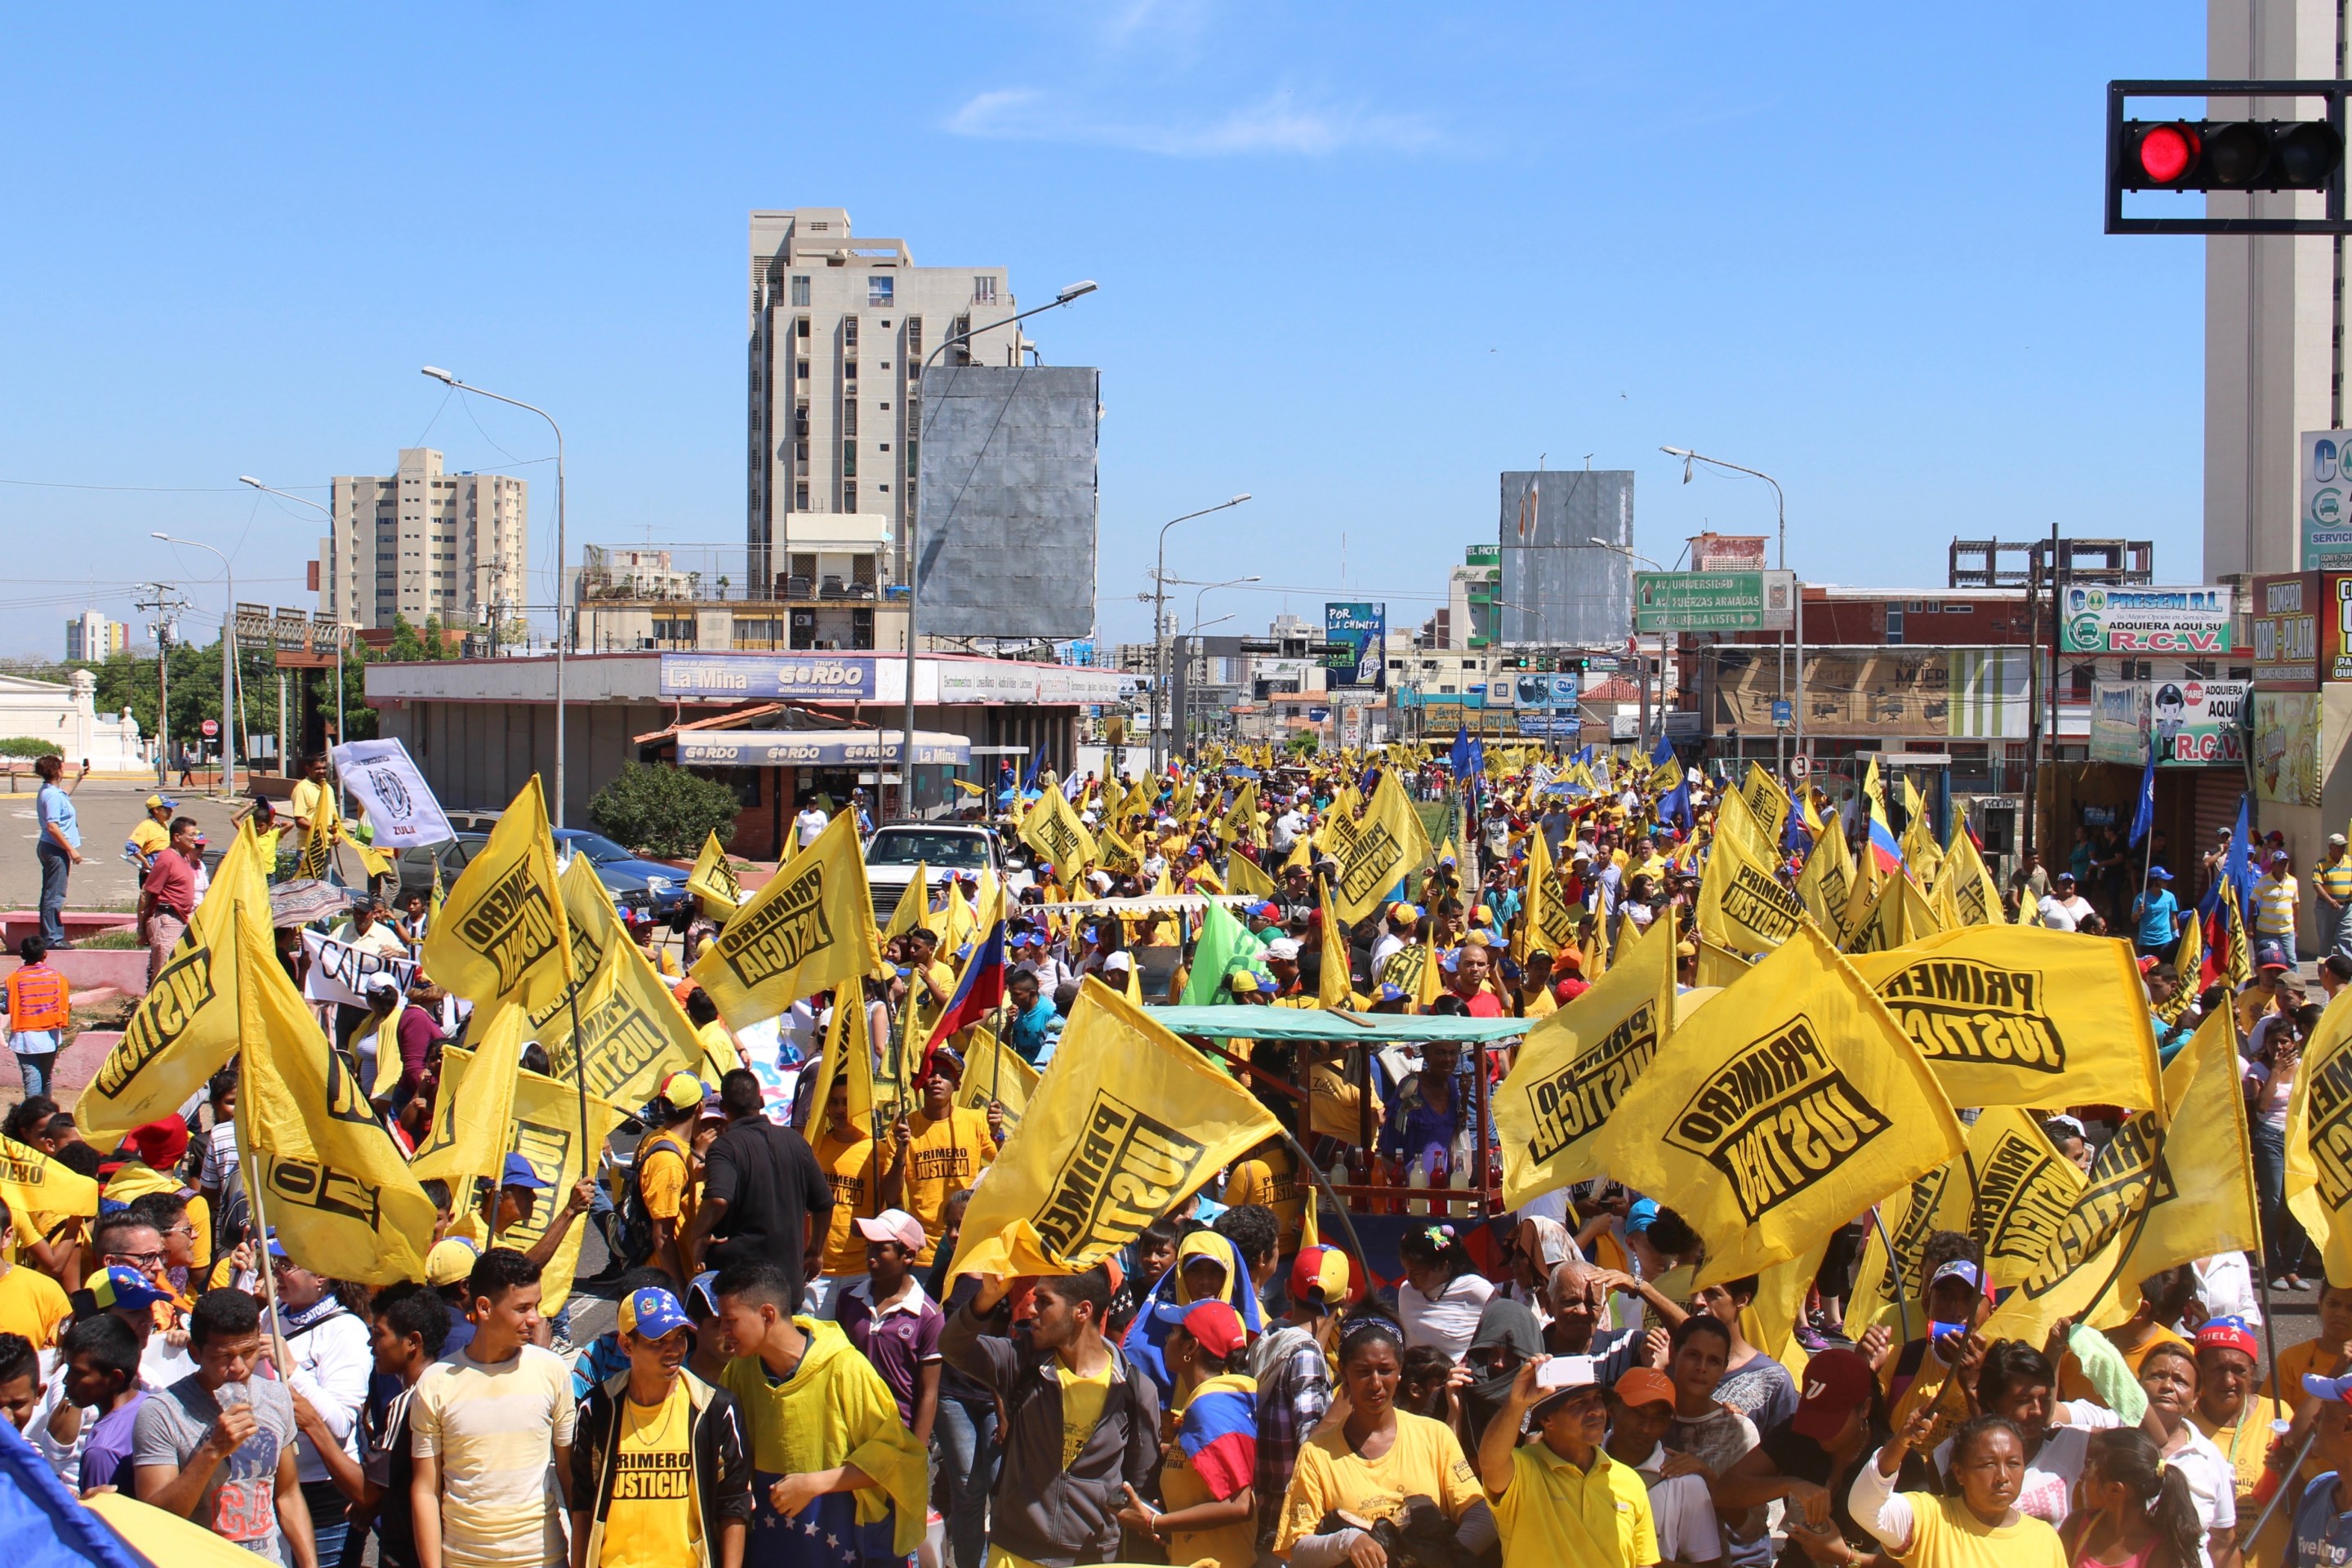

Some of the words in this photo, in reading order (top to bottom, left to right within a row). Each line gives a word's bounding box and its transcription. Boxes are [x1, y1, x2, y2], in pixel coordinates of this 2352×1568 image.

[1672, 579, 1733, 590] UNIVERSIDAD
[1715, 596, 1759, 608] ARMADAS
[2267, 583, 2301, 614] COMPRO
[1329, 608, 1351, 621] POR
[1329, 621, 1340, 630] LA
[1343, 621, 1380, 630] CHINITA
[2109, 622, 2170, 630] ADQUIERA
[2173, 621, 2203, 630] AQUÍ
[2206, 623, 2222, 631] SU
[2109, 631, 2222, 651] R.C.V.
[2255, 620, 2275, 661] ORO
[2283, 616, 2315, 661] PLATA
[1897, 660, 1930, 668] TODO
[669, 669, 692, 688] La
[698, 670, 747, 689] Mina
[778, 666, 863, 685] GORDO
[778, 686, 817, 694] millonarios
[1495, 684, 1508, 693] GM
[2185, 688, 2203, 700] PARE
[2206, 685, 2243, 696] ADQUIERA
[2208, 697, 2238, 717] AQUÍ
[2218, 721, 2229, 732] SU
[685, 746, 738, 759] GORDO
[767, 746, 821, 759] GORDO
[2176, 734, 2243, 760] R.C.V.
[920, 749, 930, 762] La
[933, 750, 956, 763] Mina
[1722, 884, 1794, 943] JUSTICIA
[915, 1147, 968, 1161] PRIMERO
[916, 1161, 969, 1180] JUSTICIA
[617, 1453, 691, 1468] RIMERO
[612, 1471, 688, 1498] USTICIA
